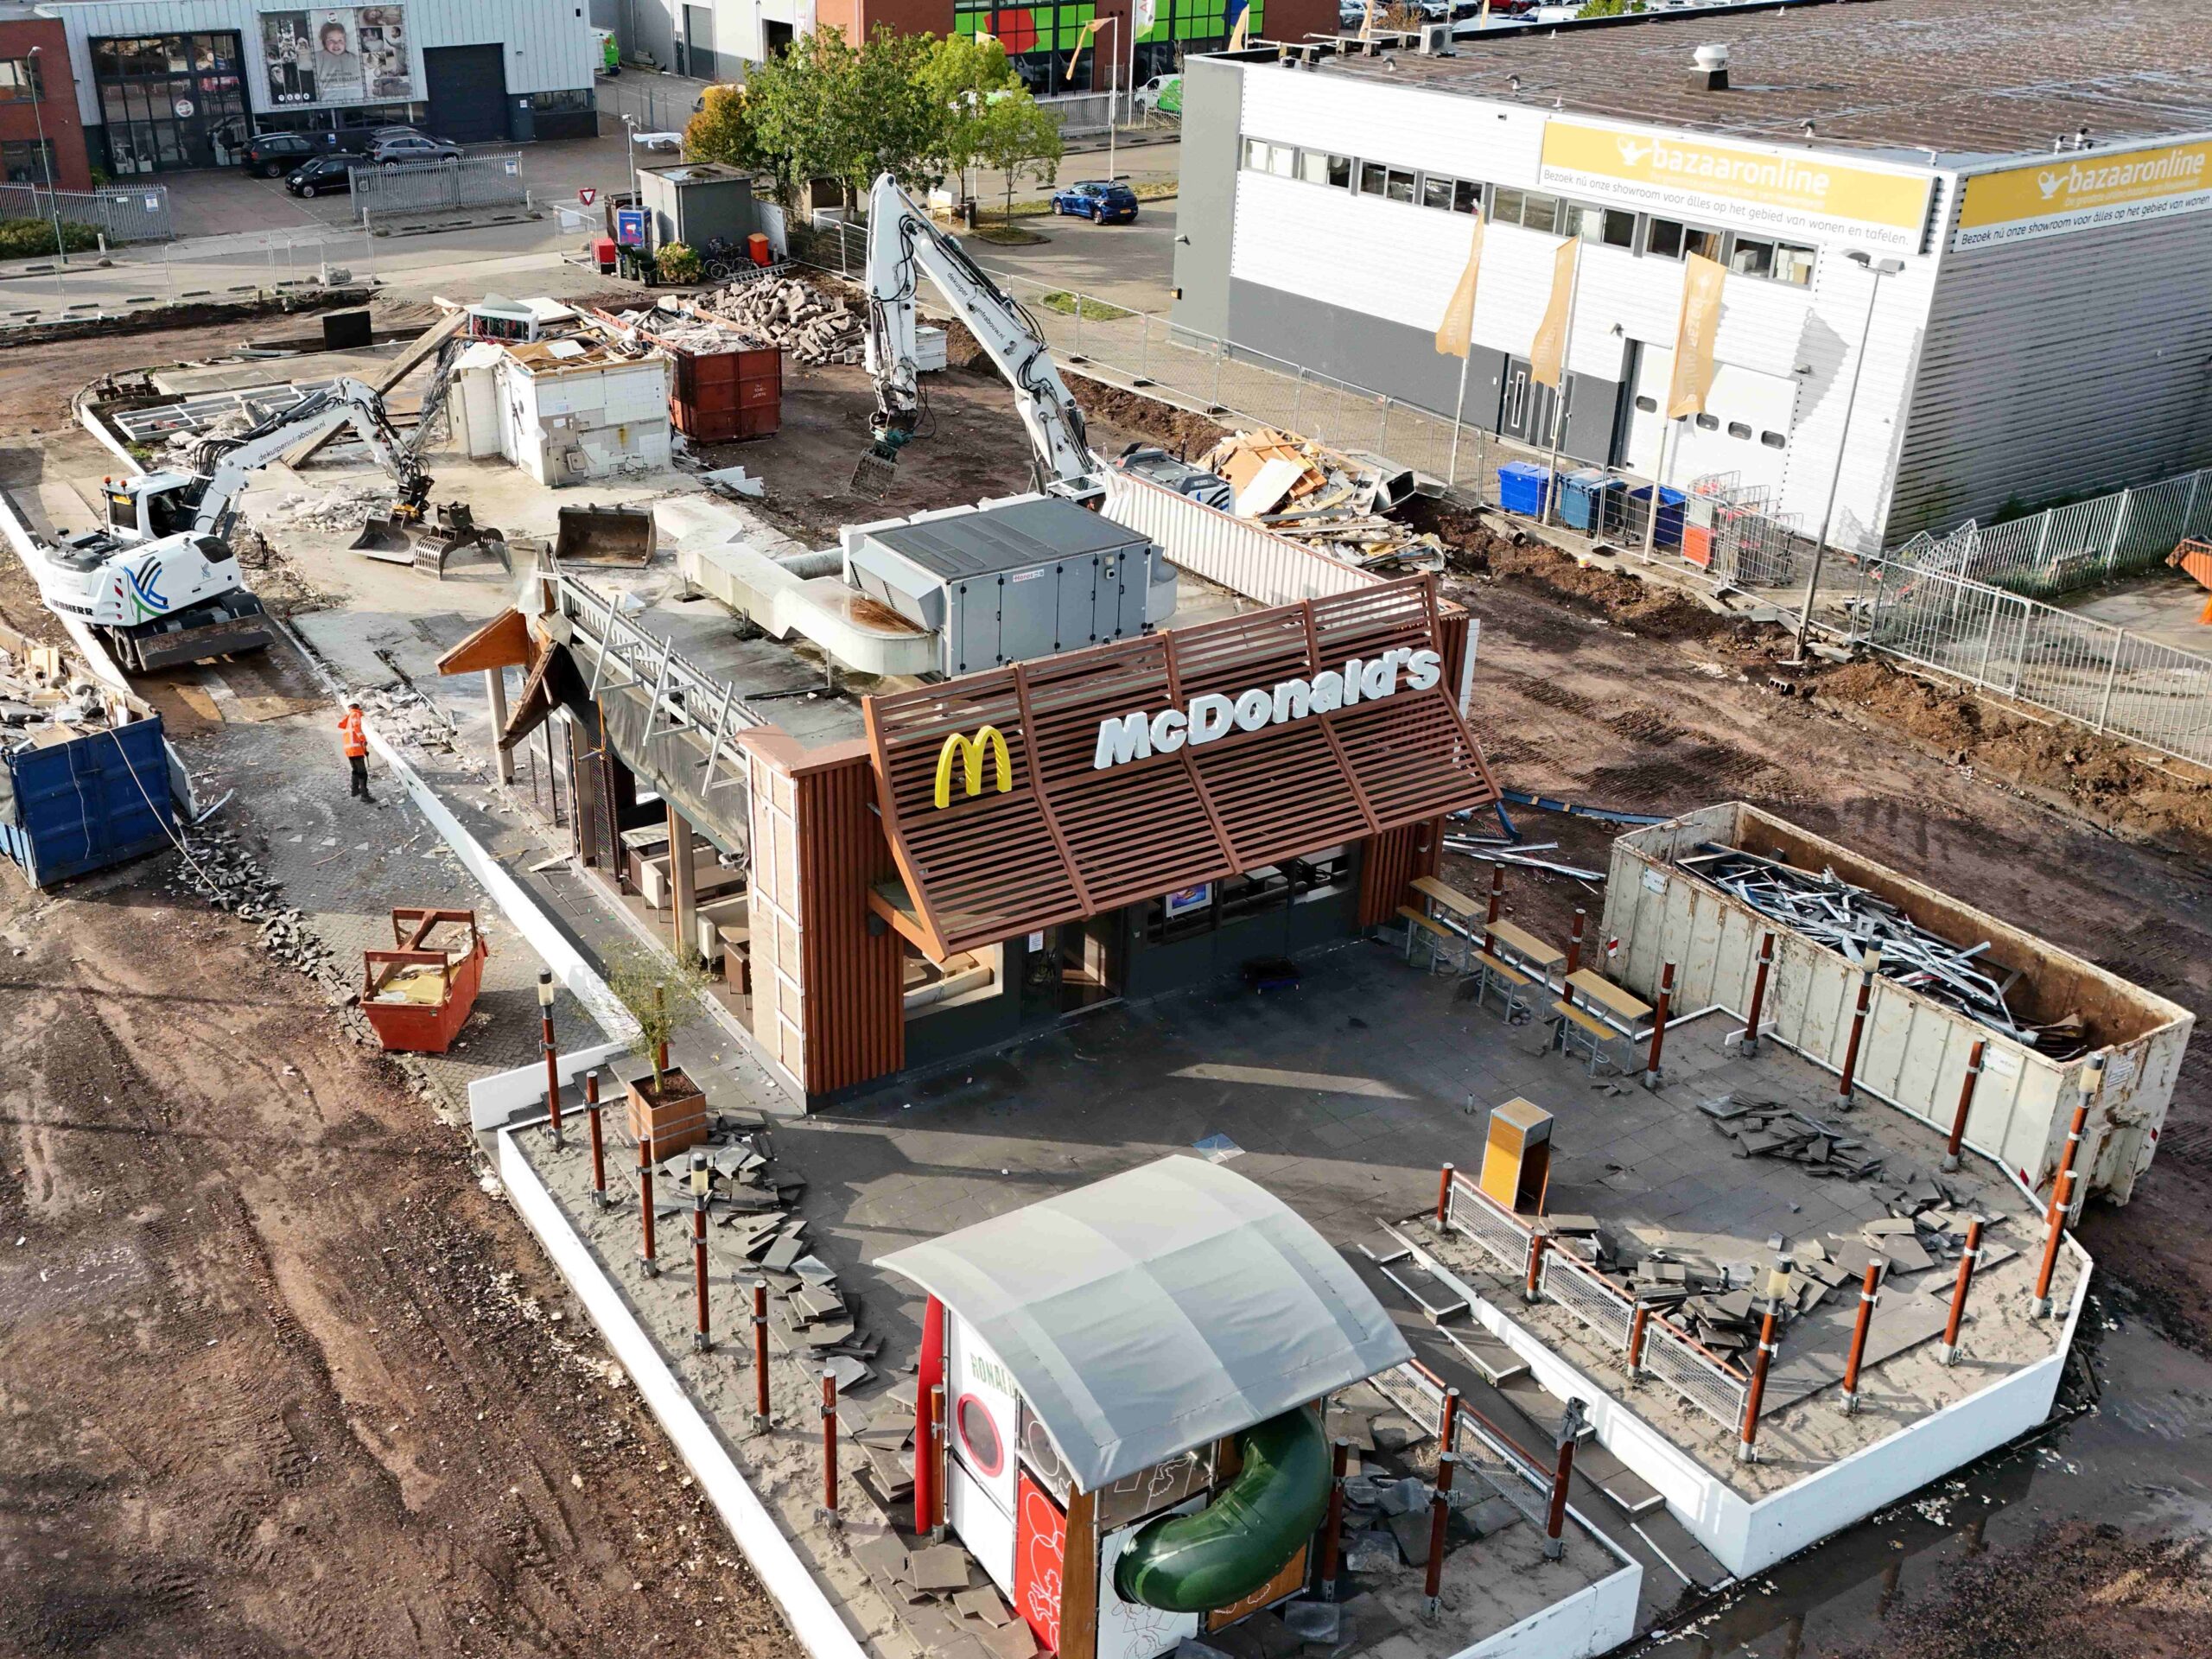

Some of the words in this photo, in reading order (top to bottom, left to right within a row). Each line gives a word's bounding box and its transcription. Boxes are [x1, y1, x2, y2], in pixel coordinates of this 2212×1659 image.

[1652, 138, 1830, 194] bazaaronline
[2067, 149, 2206, 194] bazaaronline
[1544, 169, 1573, 183] Bezoek
[1590, 180, 1610, 191] onze
[1612, 182, 1661, 200] showroom
[1663, 194, 1685, 204] voor
[1713, 201, 1726, 213] op
[1729, 200, 1746, 216] het
[1748, 207, 1783, 223] gebied
[1786, 216, 1806, 226] van
[1809, 220, 1844, 233] wonen
[1848, 227, 1862, 237] en
[1866, 228, 1909, 245] tafelen.
[1961, 230, 1991, 245] Bezoek
[2006, 226, 2026, 236] onze
[2029, 219, 2072, 233] showroom
[2074, 215, 2092, 225] voor
[2114, 209, 2126, 220] op
[2126, 206, 2141, 216] het
[2141, 201, 2167, 216] gebied
[2169, 200, 2183, 209] van
[2185, 195, 2210, 207] wonen
[947, 272, 968, 297] dekuiper
[258, 420, 327, 462] dekuiperinfrabouw.nl
[1093, 646, 1441, 771] McDonald's
